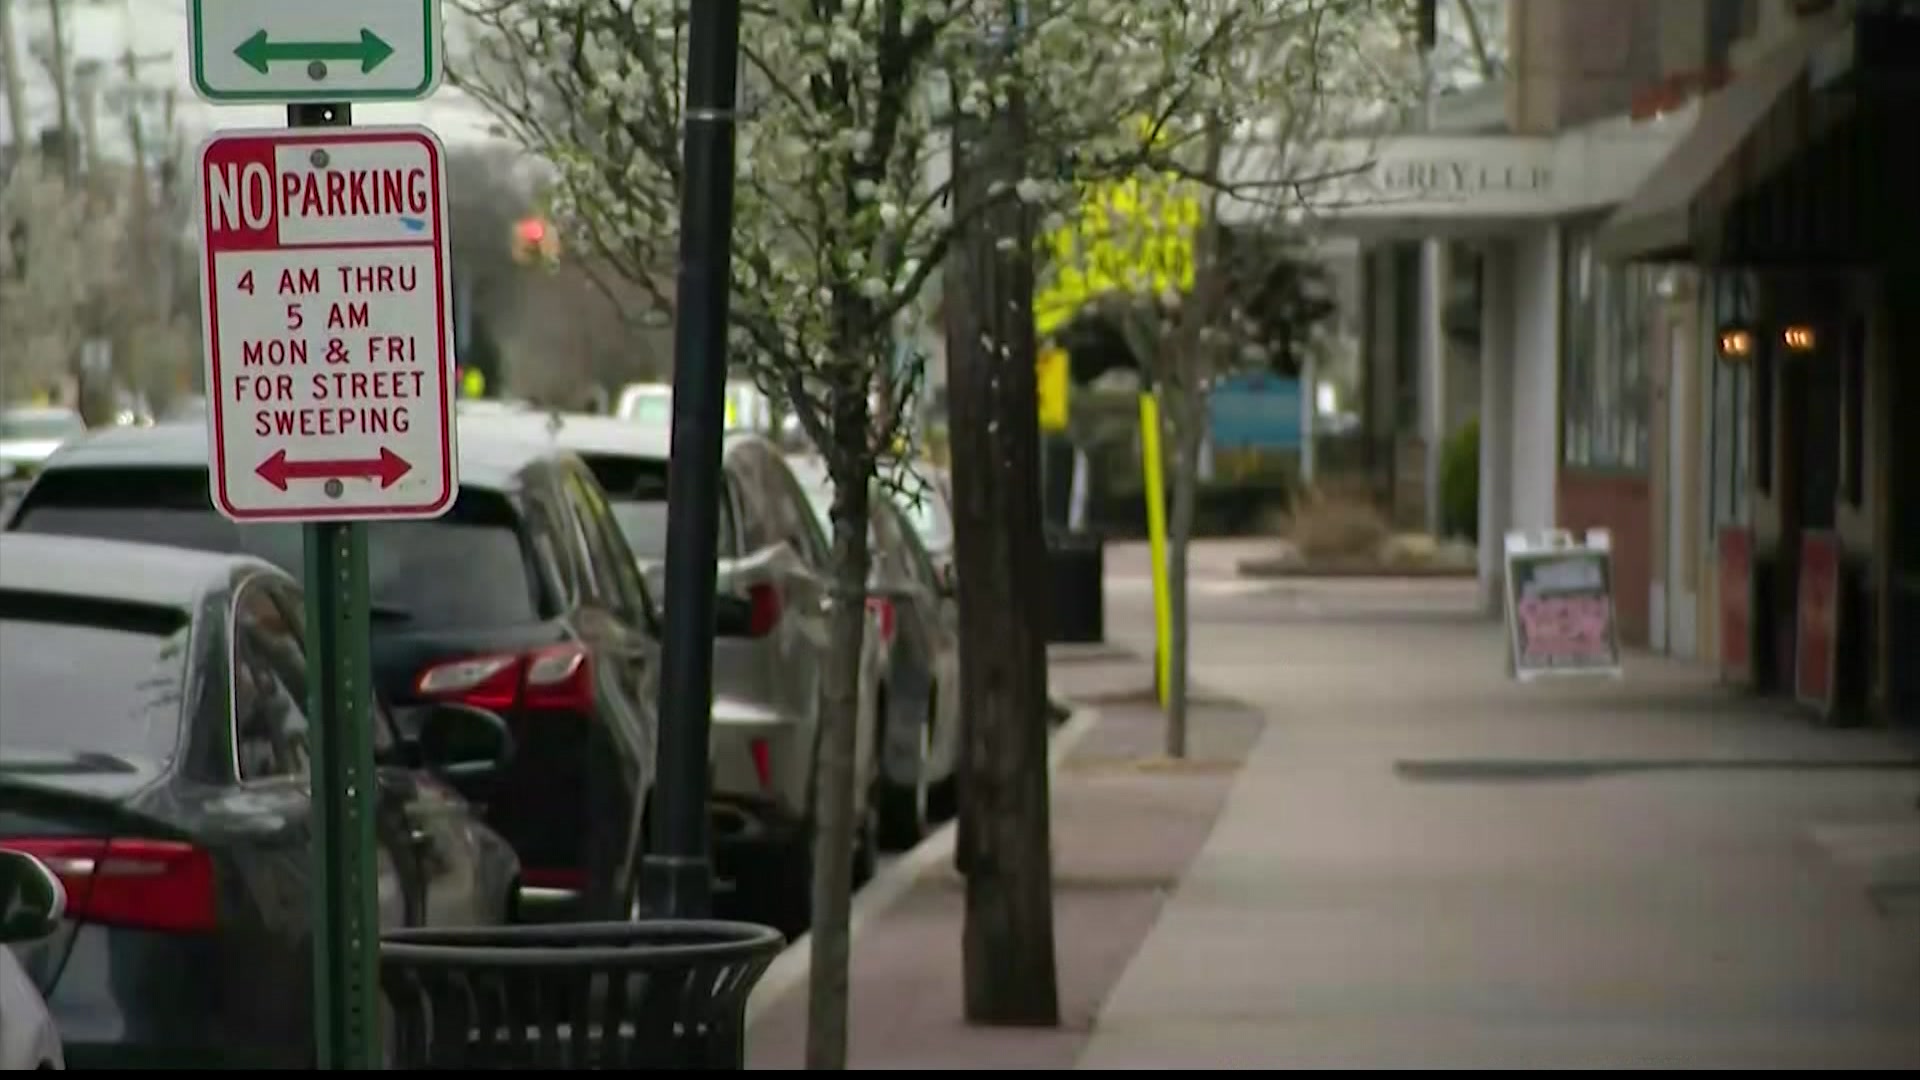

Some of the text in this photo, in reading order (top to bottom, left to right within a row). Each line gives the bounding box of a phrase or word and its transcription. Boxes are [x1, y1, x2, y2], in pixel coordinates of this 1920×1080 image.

[208, 161, 427, 232] NO PARKING
[237, 265, 417, 296] 4 AM THRU
[287, 302, 370, 331] 5 AM
[243, 337, 417, 366] MON & FRI
[235, 372, 425, 402] FOR STREET
[255, 408, 410, 436] SWEEPING
